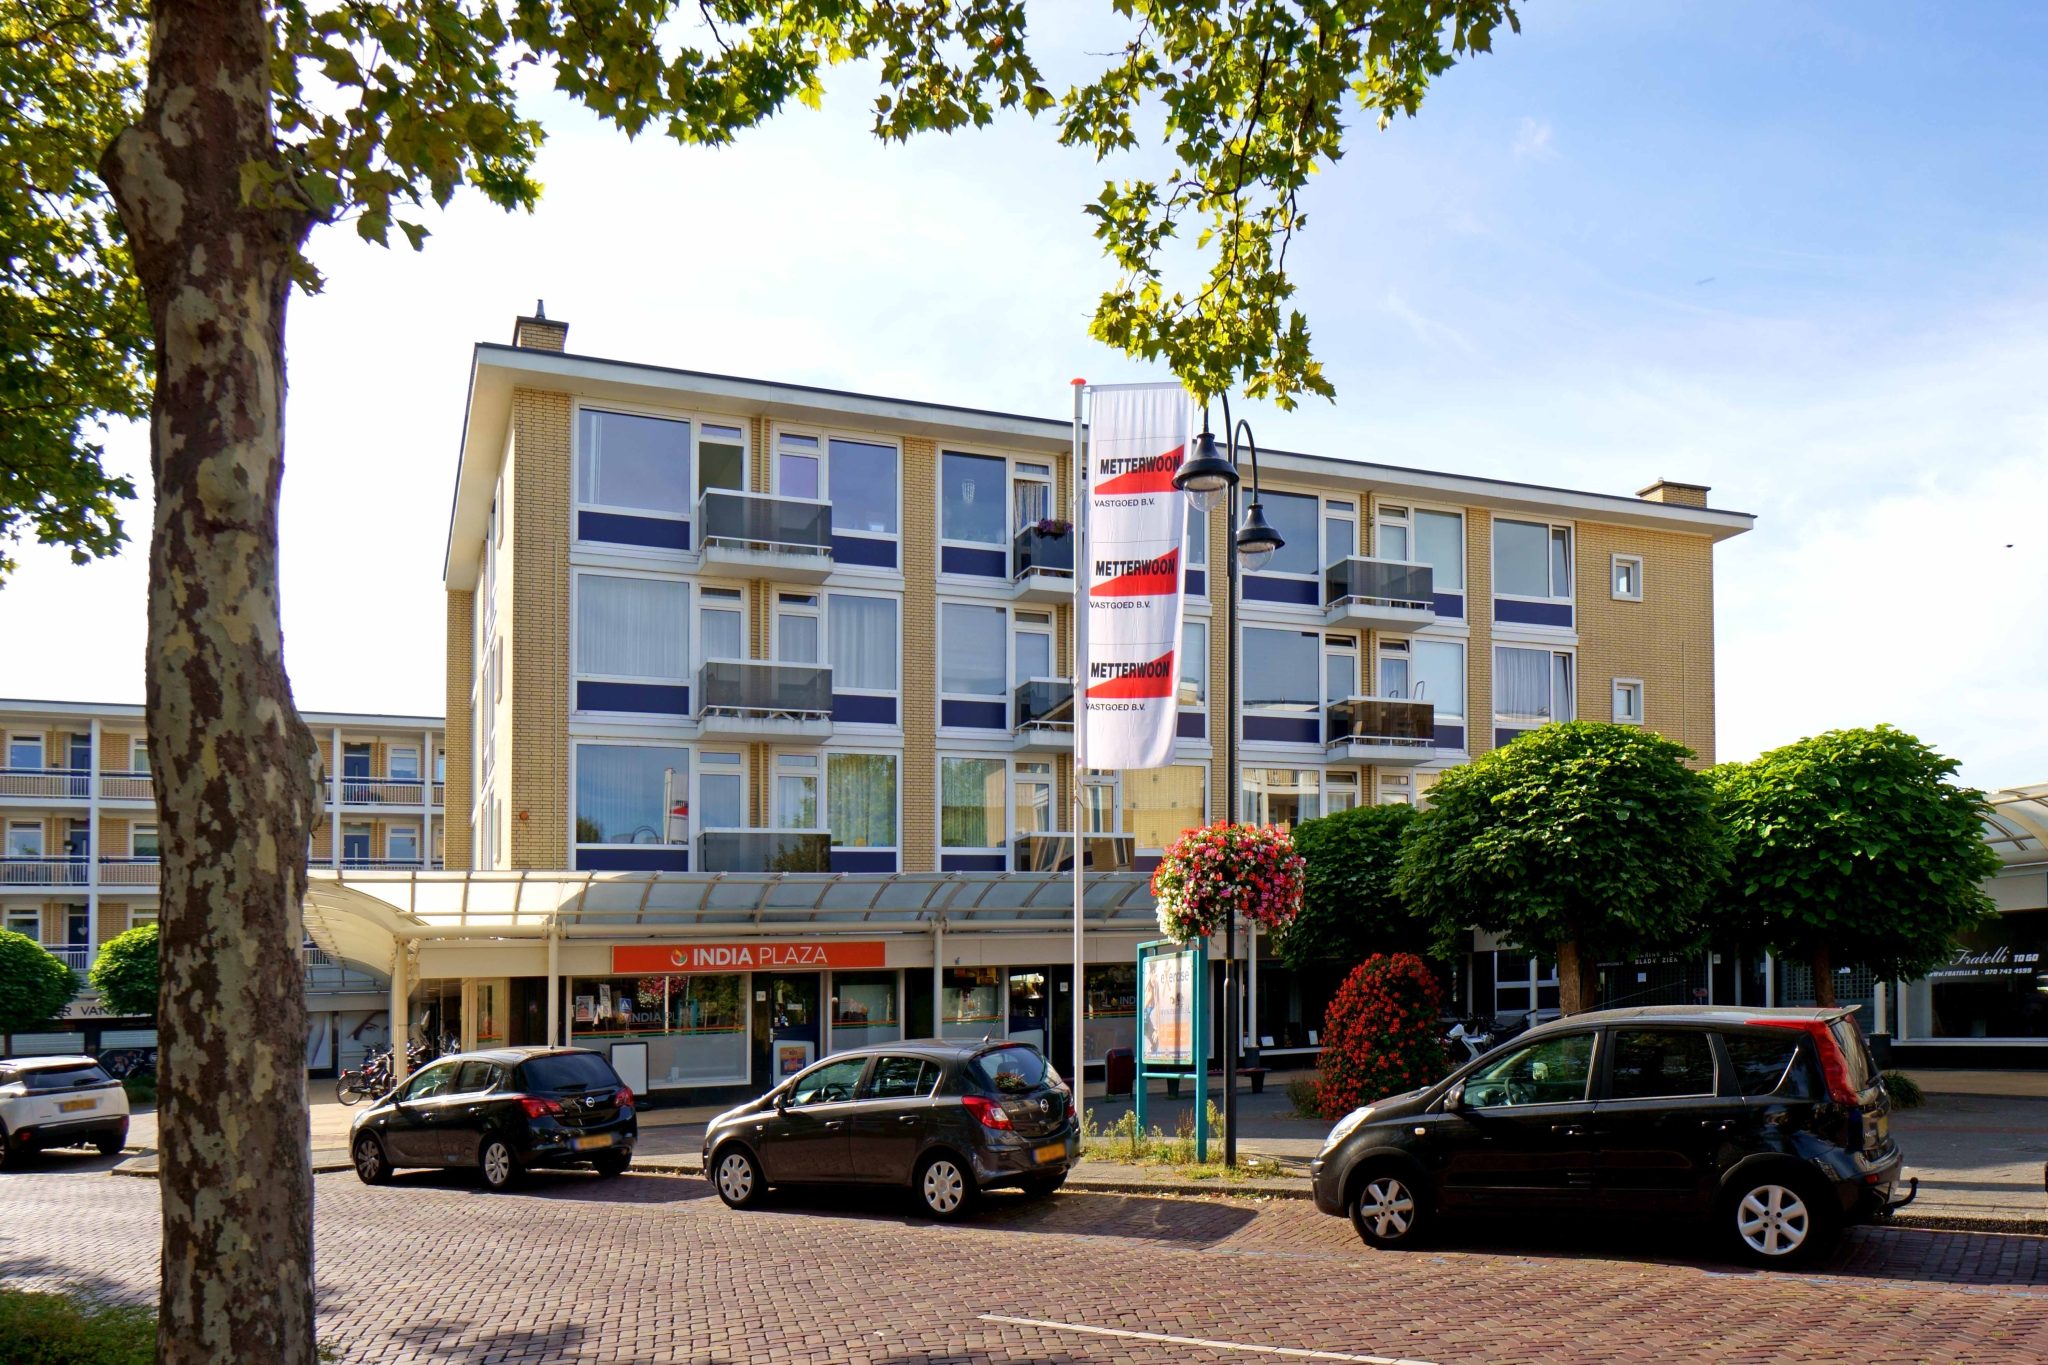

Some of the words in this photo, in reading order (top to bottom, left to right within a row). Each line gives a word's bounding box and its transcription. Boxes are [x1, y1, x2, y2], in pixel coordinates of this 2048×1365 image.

[1100, 456, 1181, 475] METTERWOON
[1094, 499, 1139, 507] VASTGOED
[1141, 498, 1155, 506] B.V.
[1095, 558, 1176, 577] METTERWOON
[1089, 601, 1135, 609] VASTGOED
[1090, 661, 1171, 679] METTERWOON
[1085, 703, 1130, 711] VASTGOED
[1131, 703, 1146, 711] B.V.
[692, 947, 754, 966] INDIA
[759, 945, 828, 965] PLAZA
[1949, 946, 2010, 966] Fratelli
